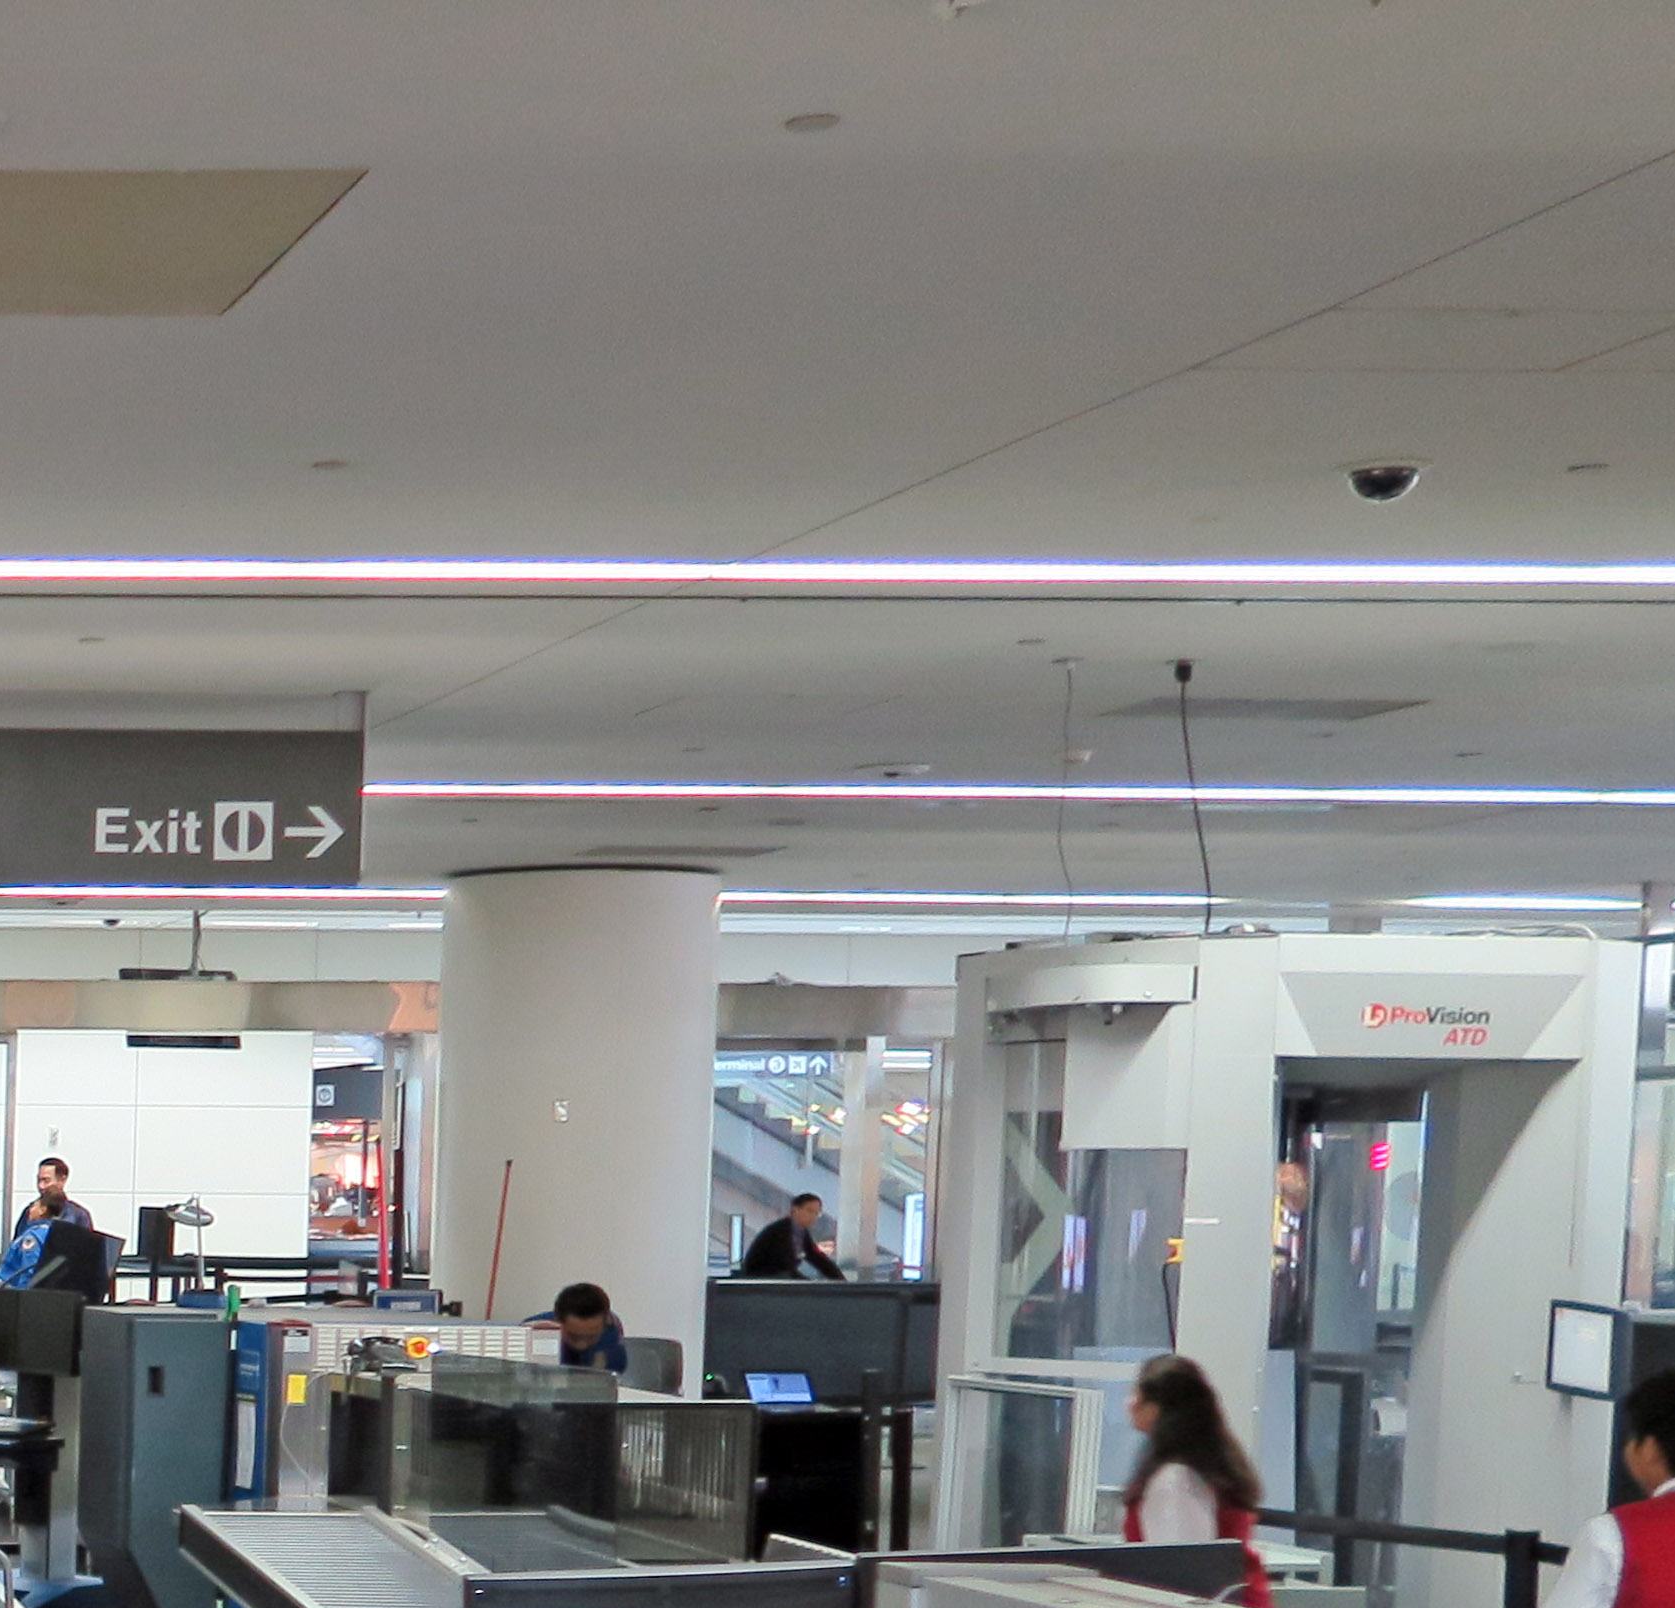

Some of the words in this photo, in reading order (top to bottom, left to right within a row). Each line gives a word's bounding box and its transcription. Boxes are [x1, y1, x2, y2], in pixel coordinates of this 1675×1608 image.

[94, 807, 202, 854] Exit
[1390, 1006, 1491, 1024] ProVision
[1443, 1027, 1488, 1046] ATD
